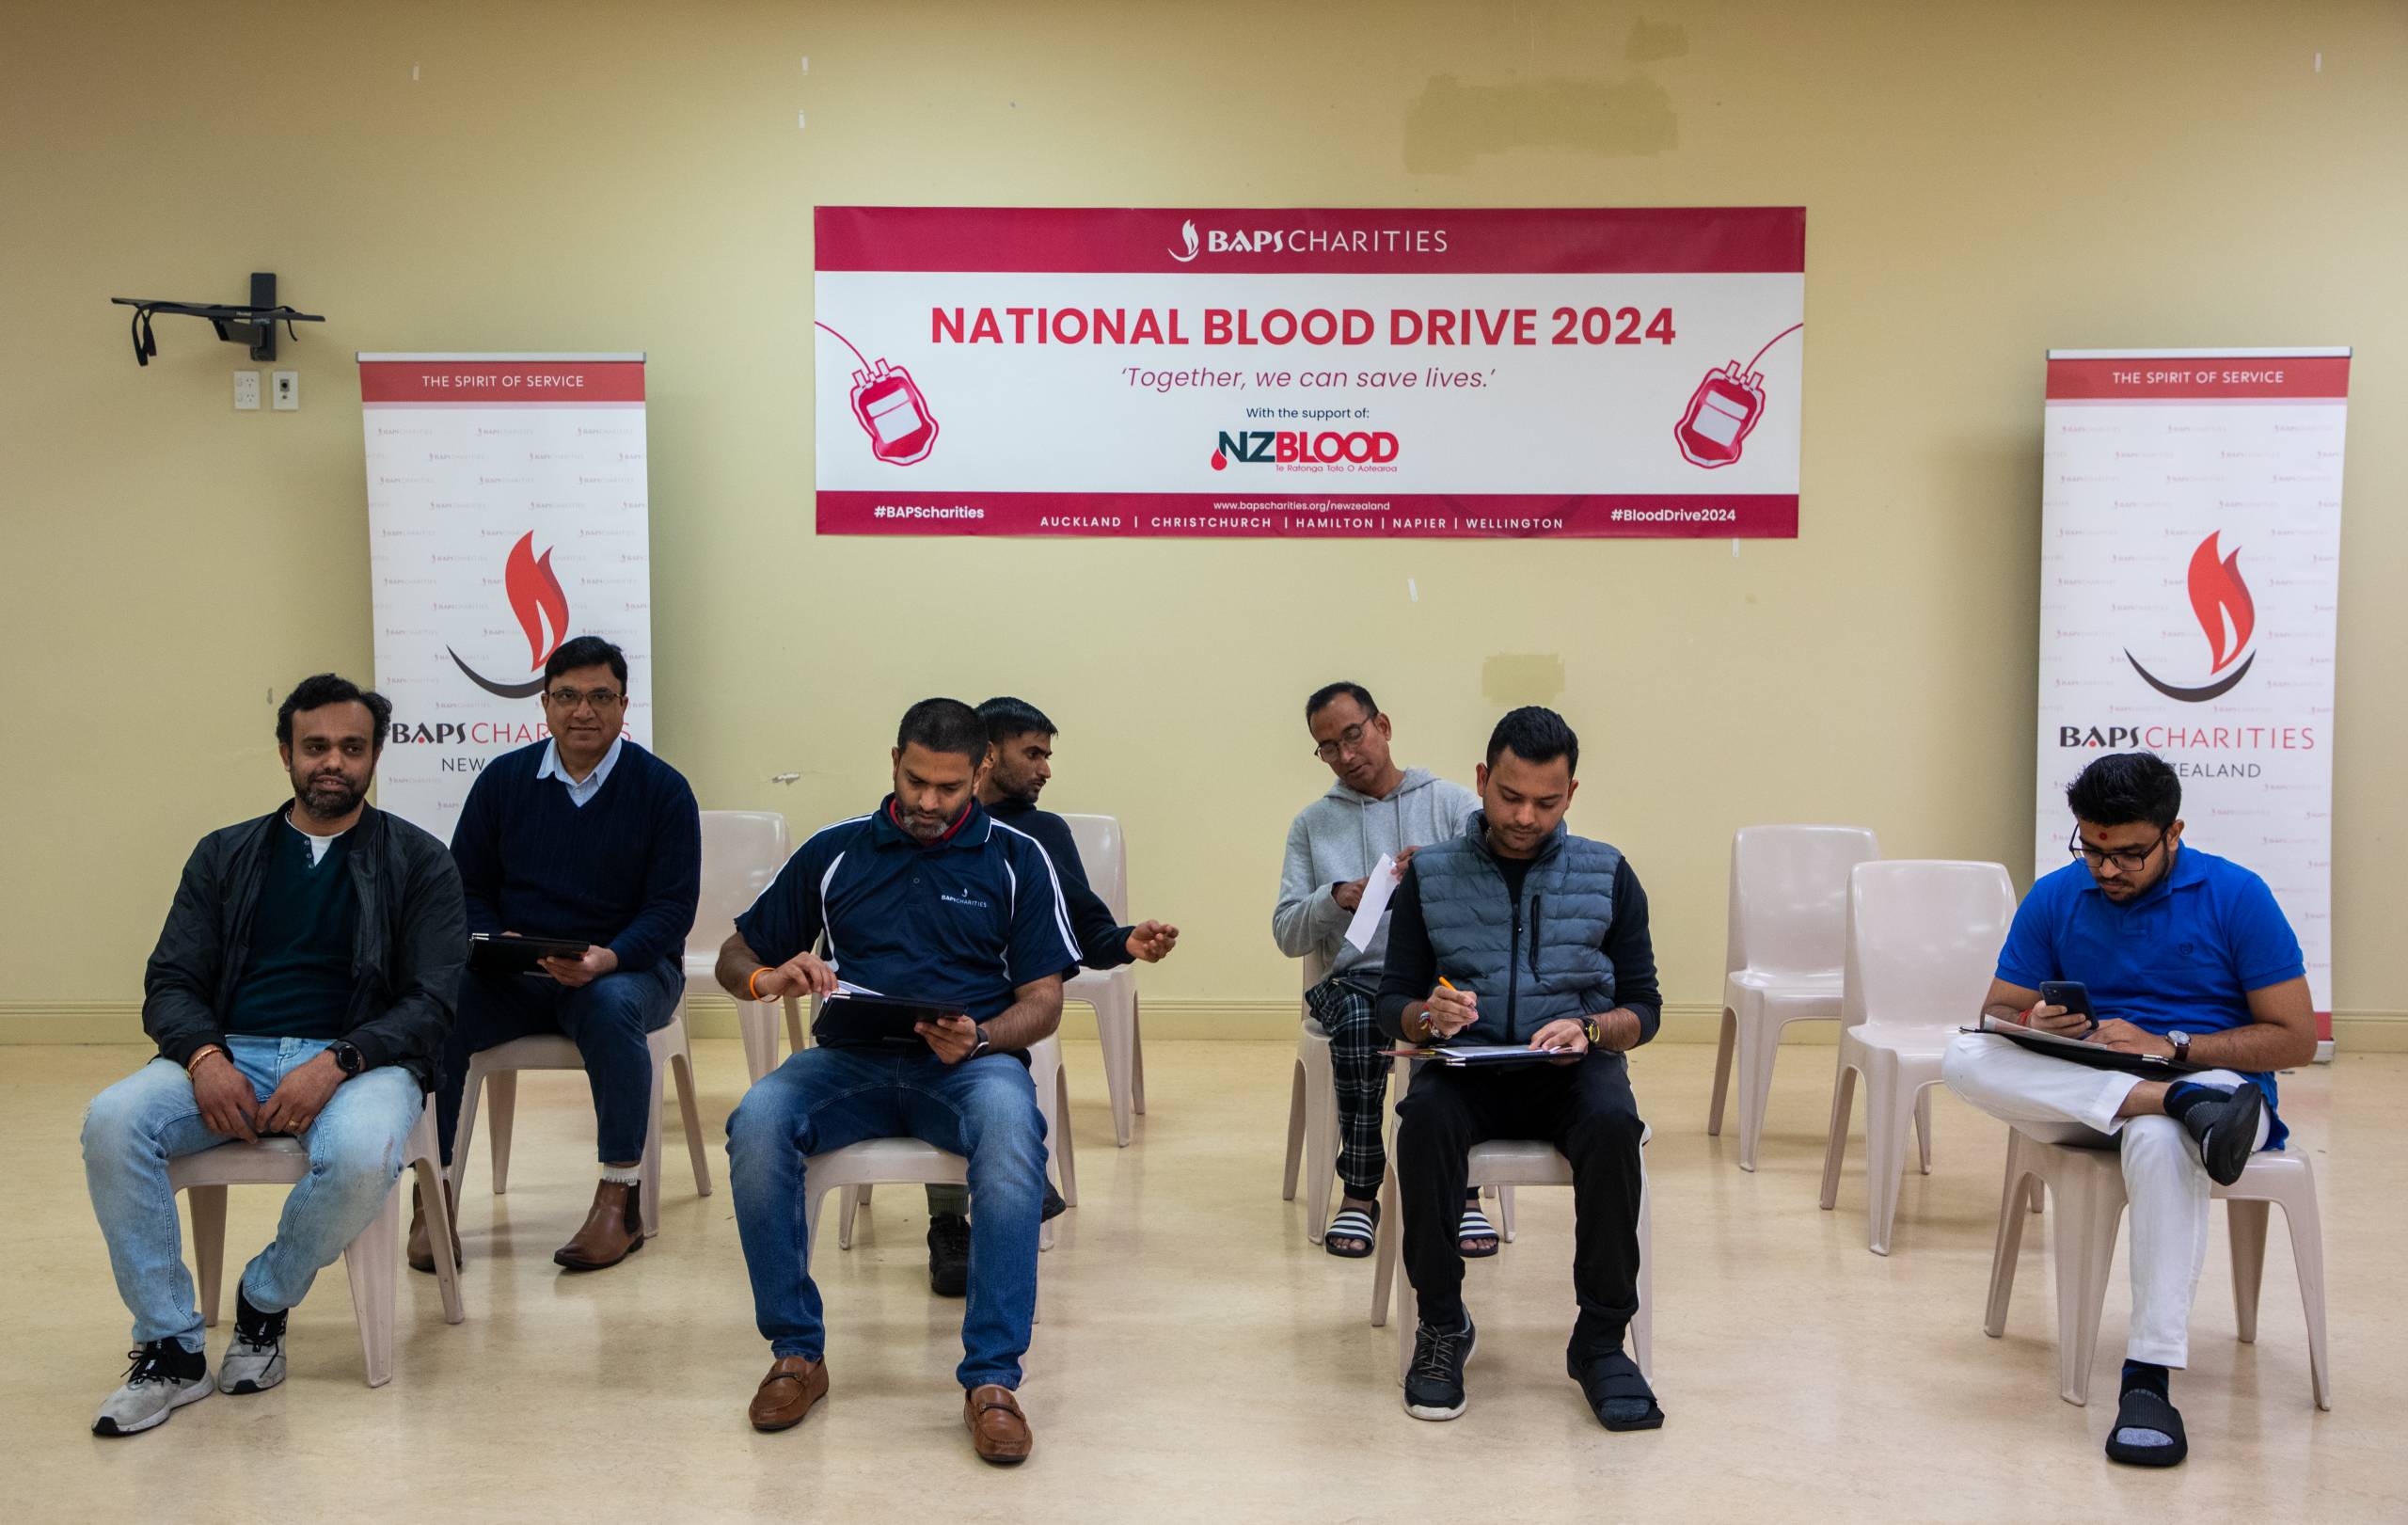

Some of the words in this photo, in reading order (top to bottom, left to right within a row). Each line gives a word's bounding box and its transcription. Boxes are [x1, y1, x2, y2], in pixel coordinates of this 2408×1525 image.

[931, 308, 1190, 345] NATIONAL
[1203, 309, 1375, 346] BLOOD
[1389, 309, 1537, 346] DRIVE
[1551, 307, 1676, 345] 2024
[422, 375, 450, 388] THE
[454, 375, 498, 388] SPIRIT
[501, 375, 521, 388] OF
[526, 374, 584, 388] SERVICE
[1256, 373, 1291, 388] we
[1299, 372, 1348, 388] can
[1355, 372, 1418, 388] save
[2113, 372, 2141, 385] THE
[2146, 371, 2191, 384] SPIRIT
[2195, 371, 2217, 384] OF
[2222, 370, 2284, 384] SERVICE
[1245, 407, 1275, 419] With
[1277, 407, 1299, 419] the
[1302, 408, 1352, 421] support
[1354, 407, 1370, 419] of:
[1287, 465, 1323, 473] Ratonga
[874, 505, 985, 519] #BAPScharities
[1213, 500, 1390, 513] www.bapscharities.org/newzealand
[1610, 508, 1736, 522] #BloodDrive2024
[1040, 516, 1121, 528] AUCKLAND
[1150, 516, 1272, 529] CHRISTCHURCH
[1295, 517, 1373, 529] HAMILTON
[1392, 517, 1446, 529] NAPIER
[1465, 517, 1562, 530] WELLINGTON
[442, 757, 485, 771] NEW
